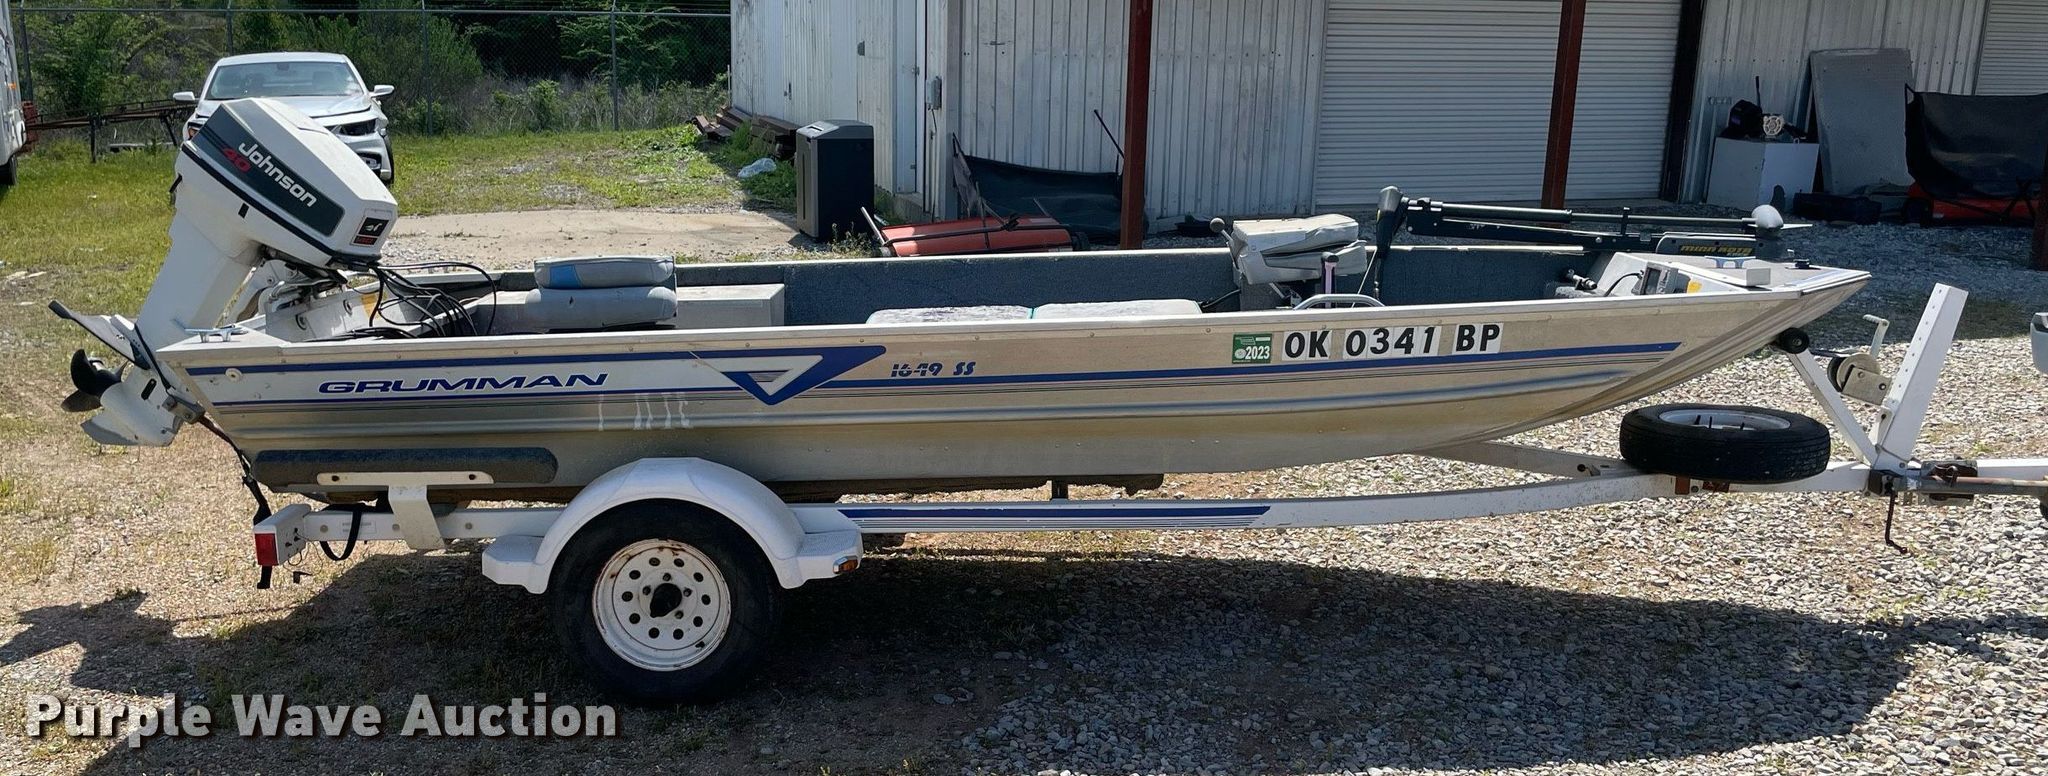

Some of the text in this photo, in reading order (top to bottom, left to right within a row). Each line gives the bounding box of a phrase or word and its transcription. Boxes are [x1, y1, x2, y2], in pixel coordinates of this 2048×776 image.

[223, 148, 251, 172] 40
[238, 142, 317, 207] Johnson
[1285, 324, 1500, 358] OK 0341 BP
[1245, 345, 1270, 360] 2023
[953, 361, 976, 376] SS
[318, 373, 608, 394] GRUMMAN
